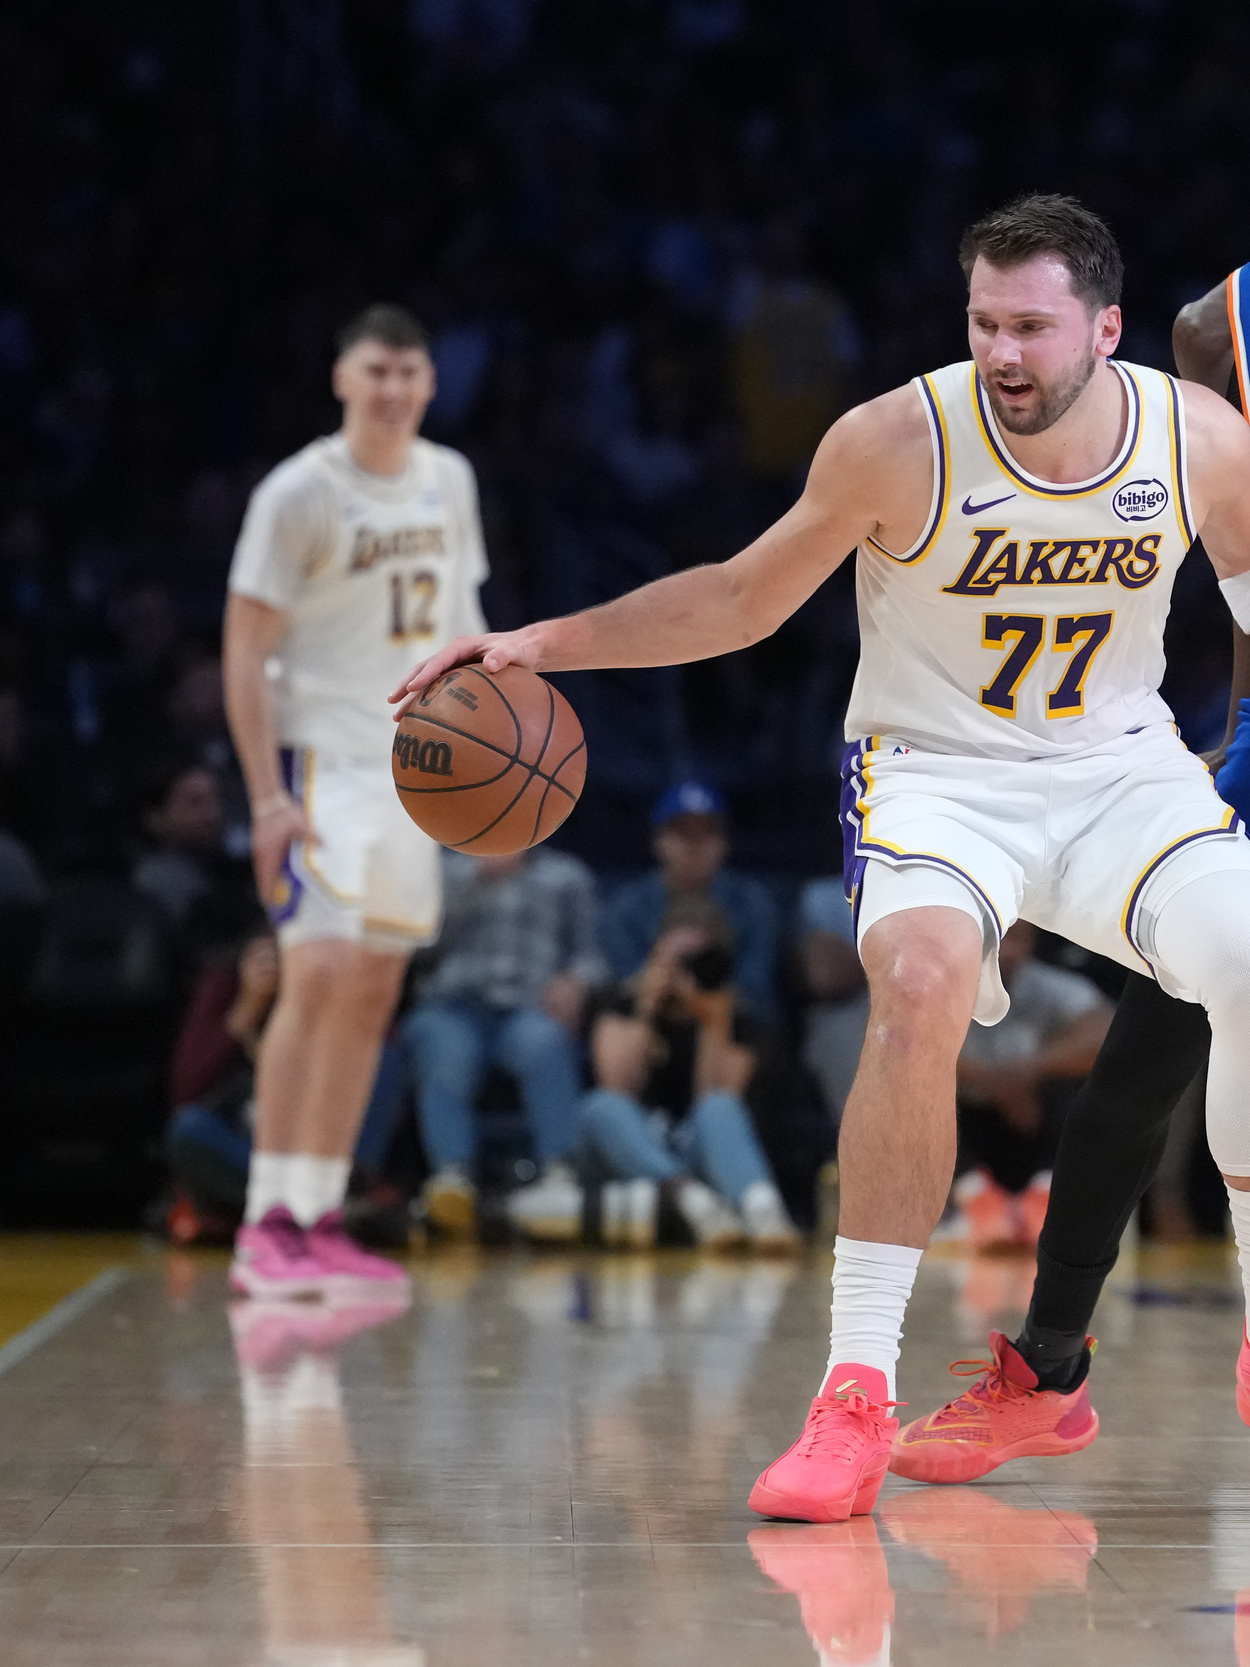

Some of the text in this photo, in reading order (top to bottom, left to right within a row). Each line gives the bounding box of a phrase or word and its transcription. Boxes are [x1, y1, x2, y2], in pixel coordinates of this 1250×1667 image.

[1118, 490, 1165, 508] bibigo
[1126, 505, 1147, 513] 비비고
[939, 527, 1165, 598] LAKERS
[388, 571, 438, 643] 12
[978, 610, 1116, 721] 77
